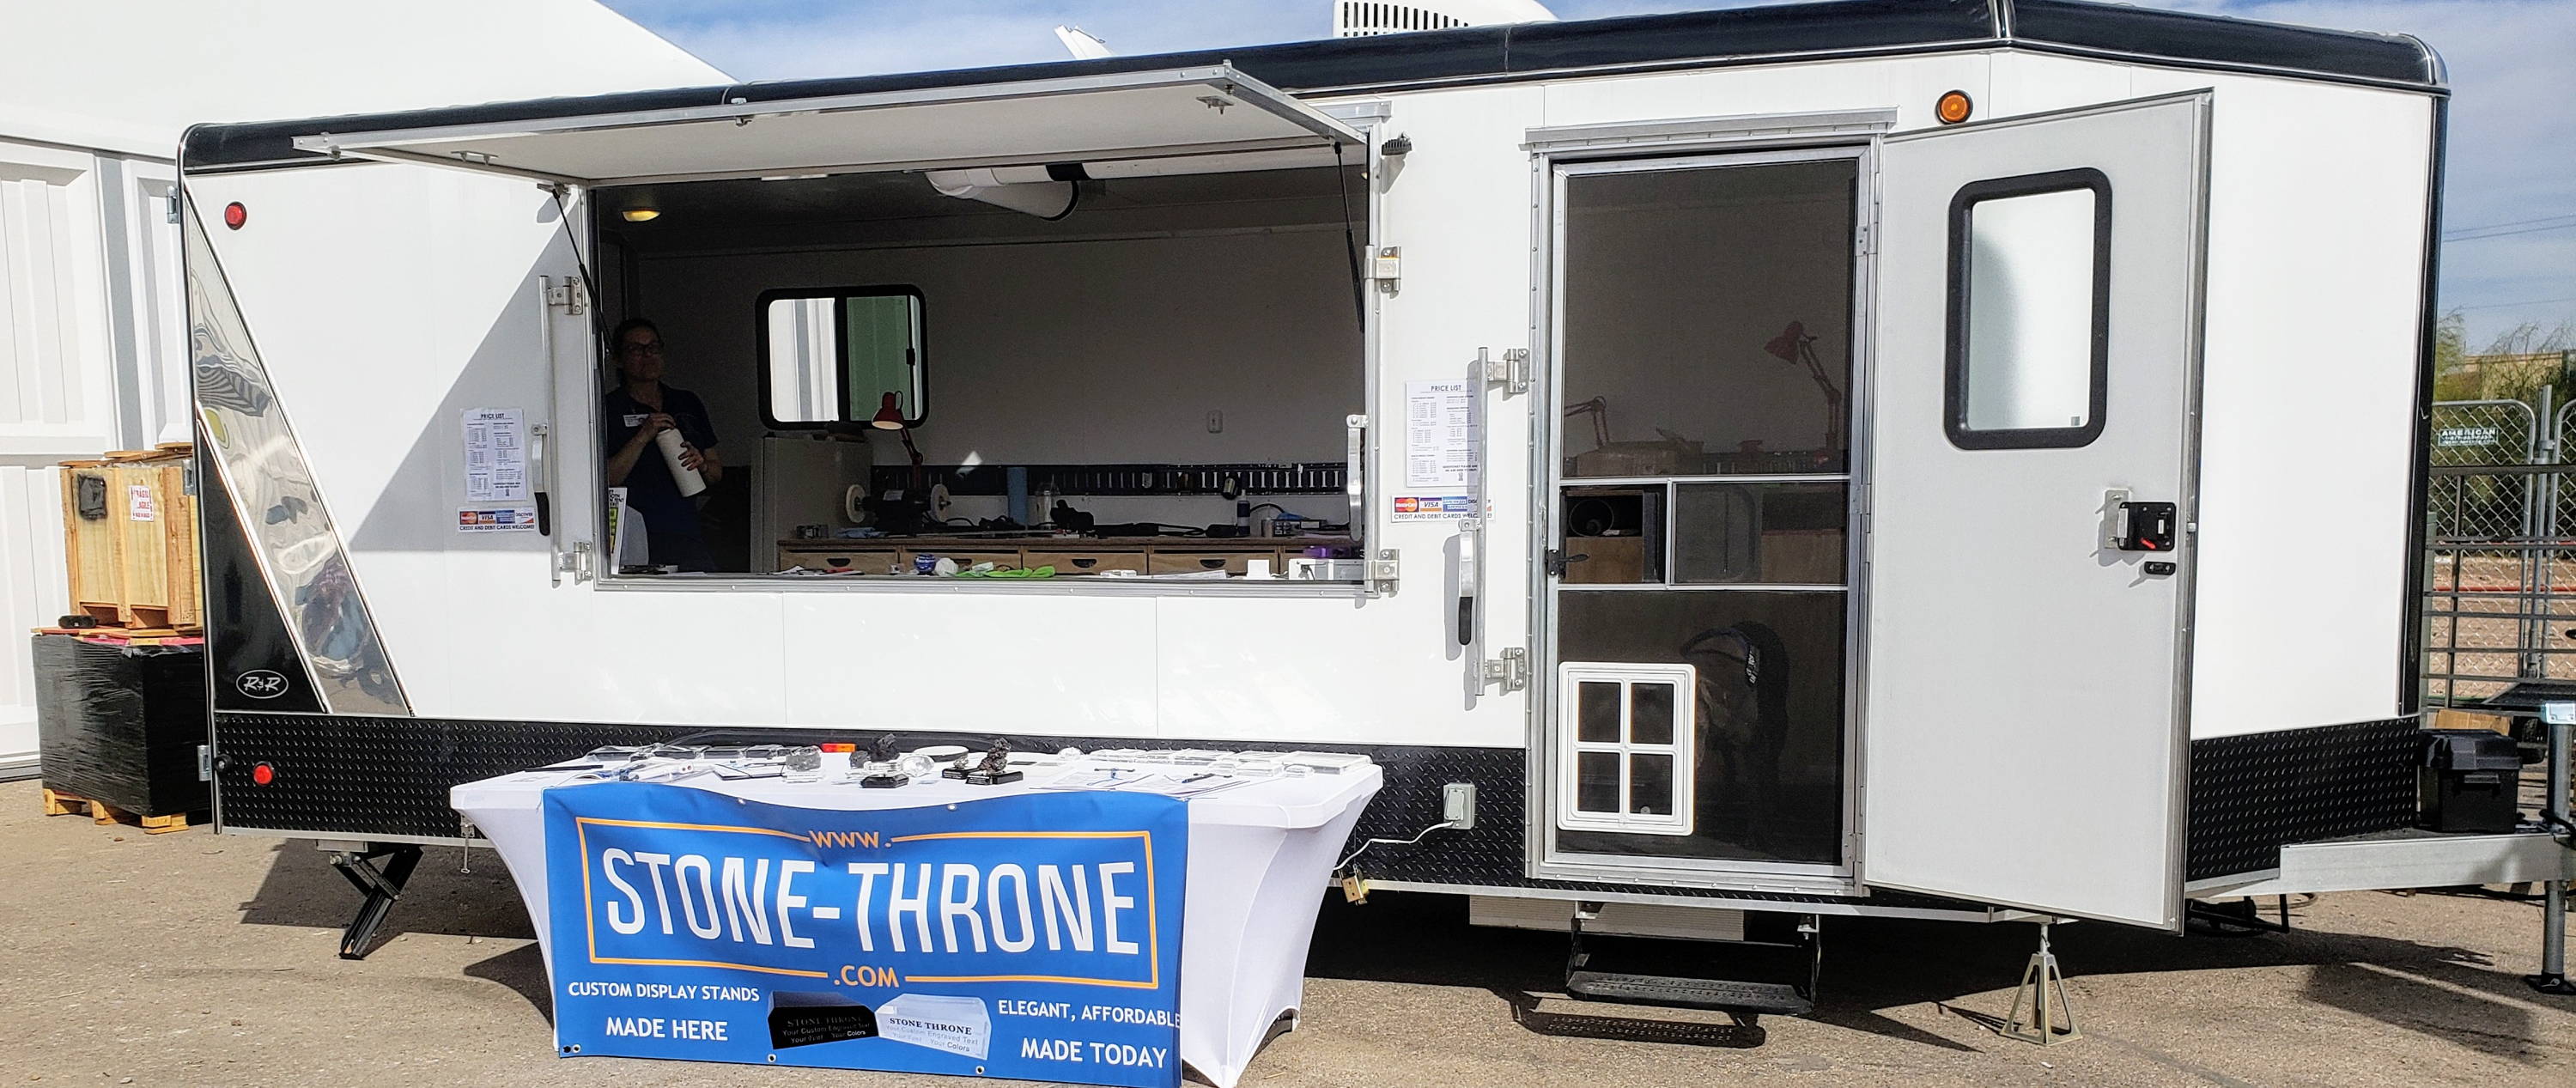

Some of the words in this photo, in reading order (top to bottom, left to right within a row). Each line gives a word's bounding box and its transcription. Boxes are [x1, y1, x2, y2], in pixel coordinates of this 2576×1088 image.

[601, 848, 1139, 956] STONE-THRONE
[832, 964, 900, 988] .COM
[568, 982, 632, 999] CUSTOM
[635, 983, 697, 1001] DISPLAY
[701, 985, 760, 1002] STANDS
[998, 999, 1077, 1022] ELEGANT,
[1081, 1005, 1181, 1030] AFFORDABLE
[605, 1016, 665, 1039] MADE
[671, 1020, 728, 1042] HERE
[800, 1026, 827, 1035] Custom
[890, 1018, 923, 1028] STONE
[925, 1022, 972, 1036] THRONE
[927, 1030, 961, 1042] Engraved
[963, 1036, 979, 1046] Text
[930, 1038, 946, 1047] Your
[946, 1042, 970, 1053] Colors
[1021, 1037, 1084, 1063] MADE
[1089, 1043, 1169, 1068] TODAY
